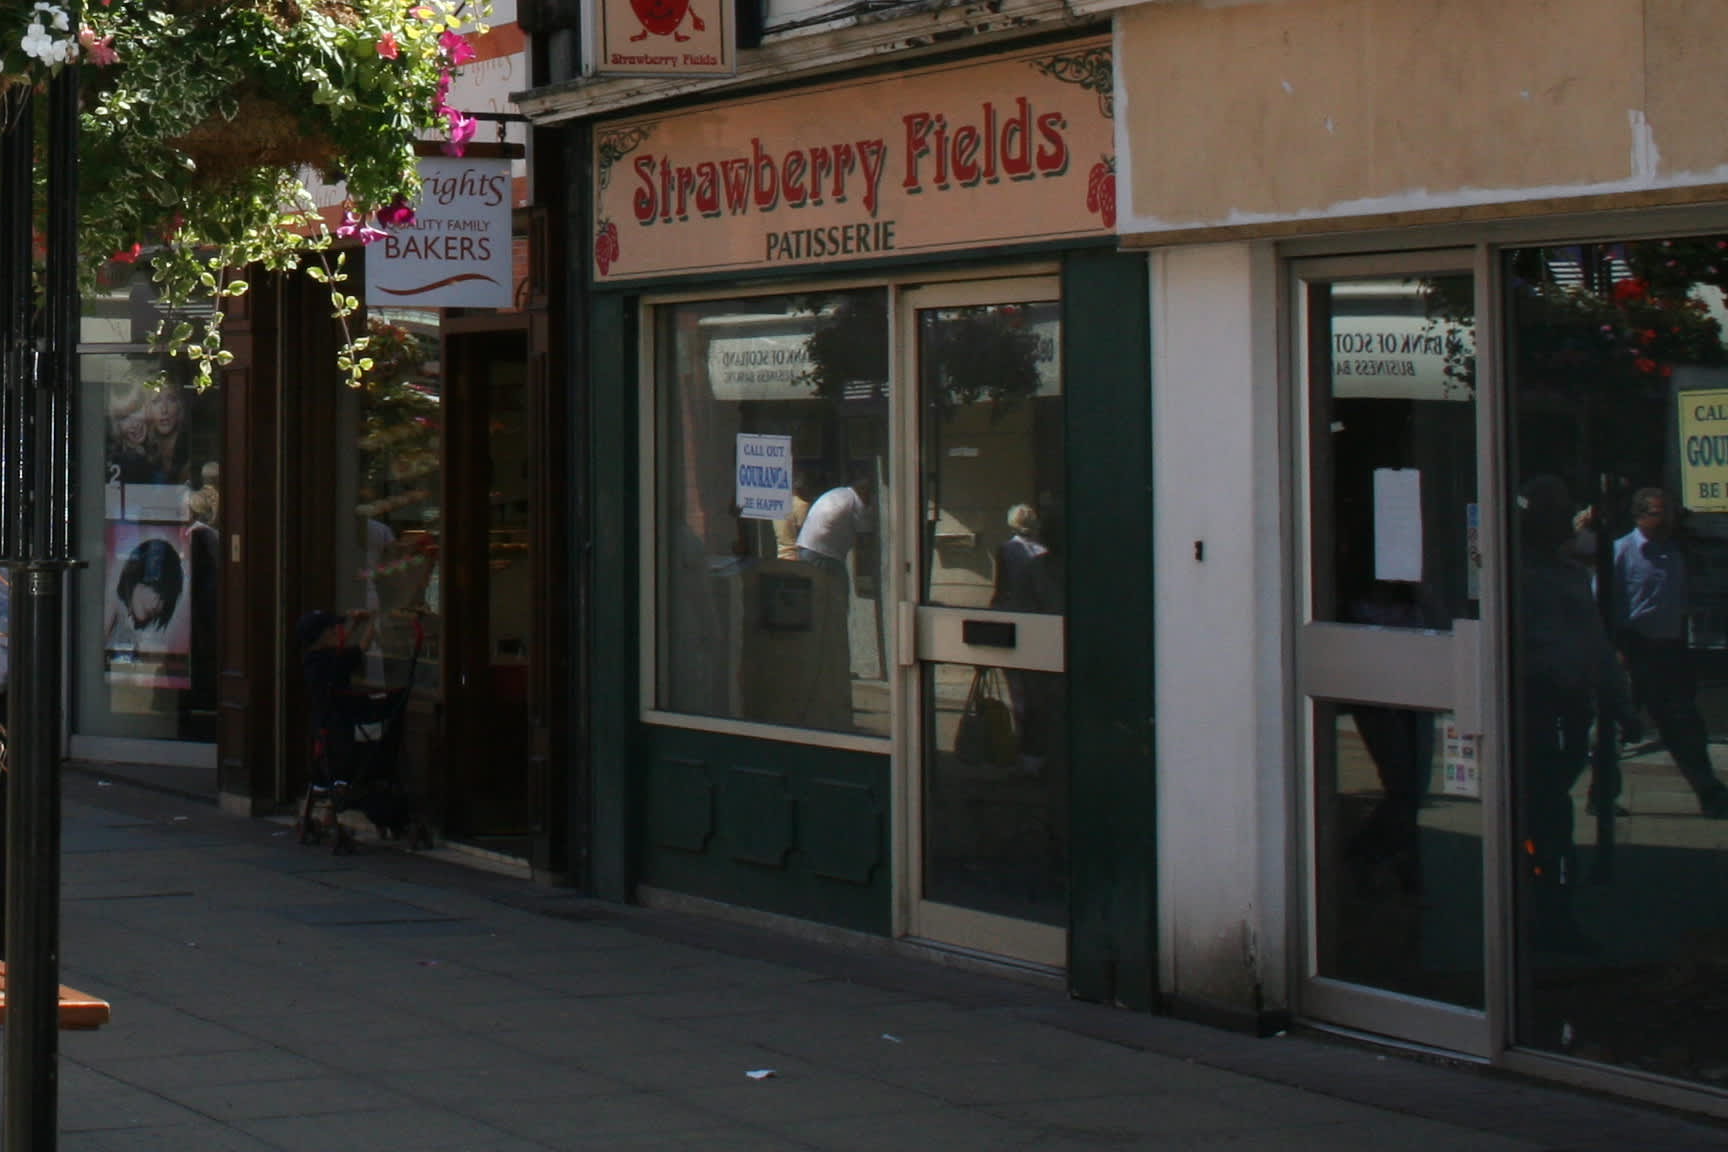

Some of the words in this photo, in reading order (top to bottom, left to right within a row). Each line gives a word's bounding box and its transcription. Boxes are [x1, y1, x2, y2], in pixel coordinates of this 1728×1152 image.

[611, 54, 677, 67] Strawberry
[683, 54, 718, 65] Fields
[633, 137, 888, 226] Strawberry
[902, 96, 1068, 193] Fields
[447, 219, 490, 232] FAMILY
[385, 236, 491, 260] BAKERS
[766, 220, 896, 261] PATISSERIE
[1694, 405, 1728, 421] CAL
[744, 444, 765, 456] CALL
[767, 446, 785, 457] OUT
[1699, 482, 1720, 498] BE
[756, 497, 784, 511] HAPPY
